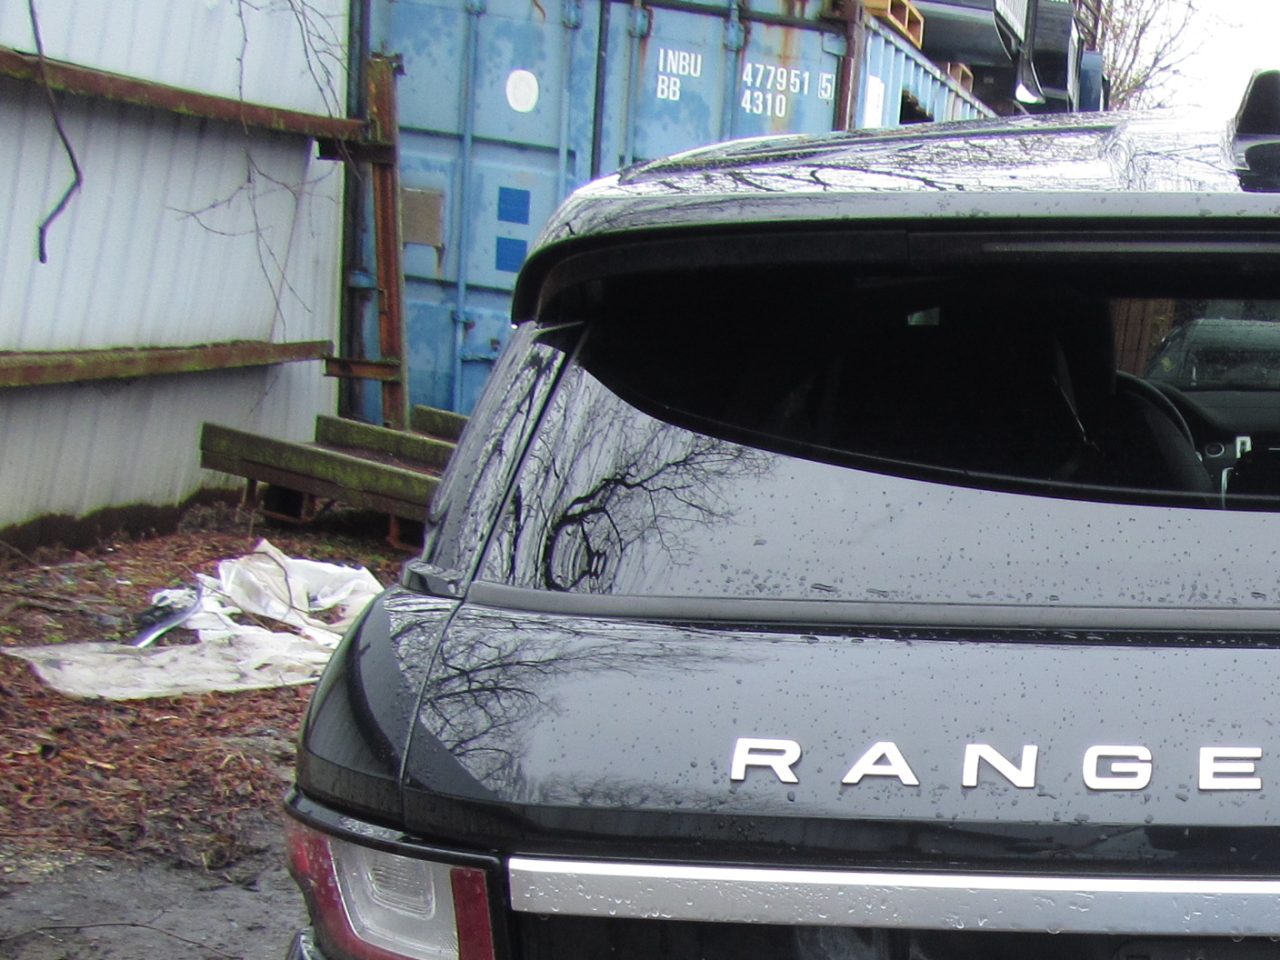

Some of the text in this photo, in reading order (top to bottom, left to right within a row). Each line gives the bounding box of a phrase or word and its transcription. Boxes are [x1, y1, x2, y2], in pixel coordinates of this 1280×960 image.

[657, 75, 787, 118] BB 4310
[658, 48, 833, 98] INBU 477951 5
[730, 737, 1263, 791] RANGE
